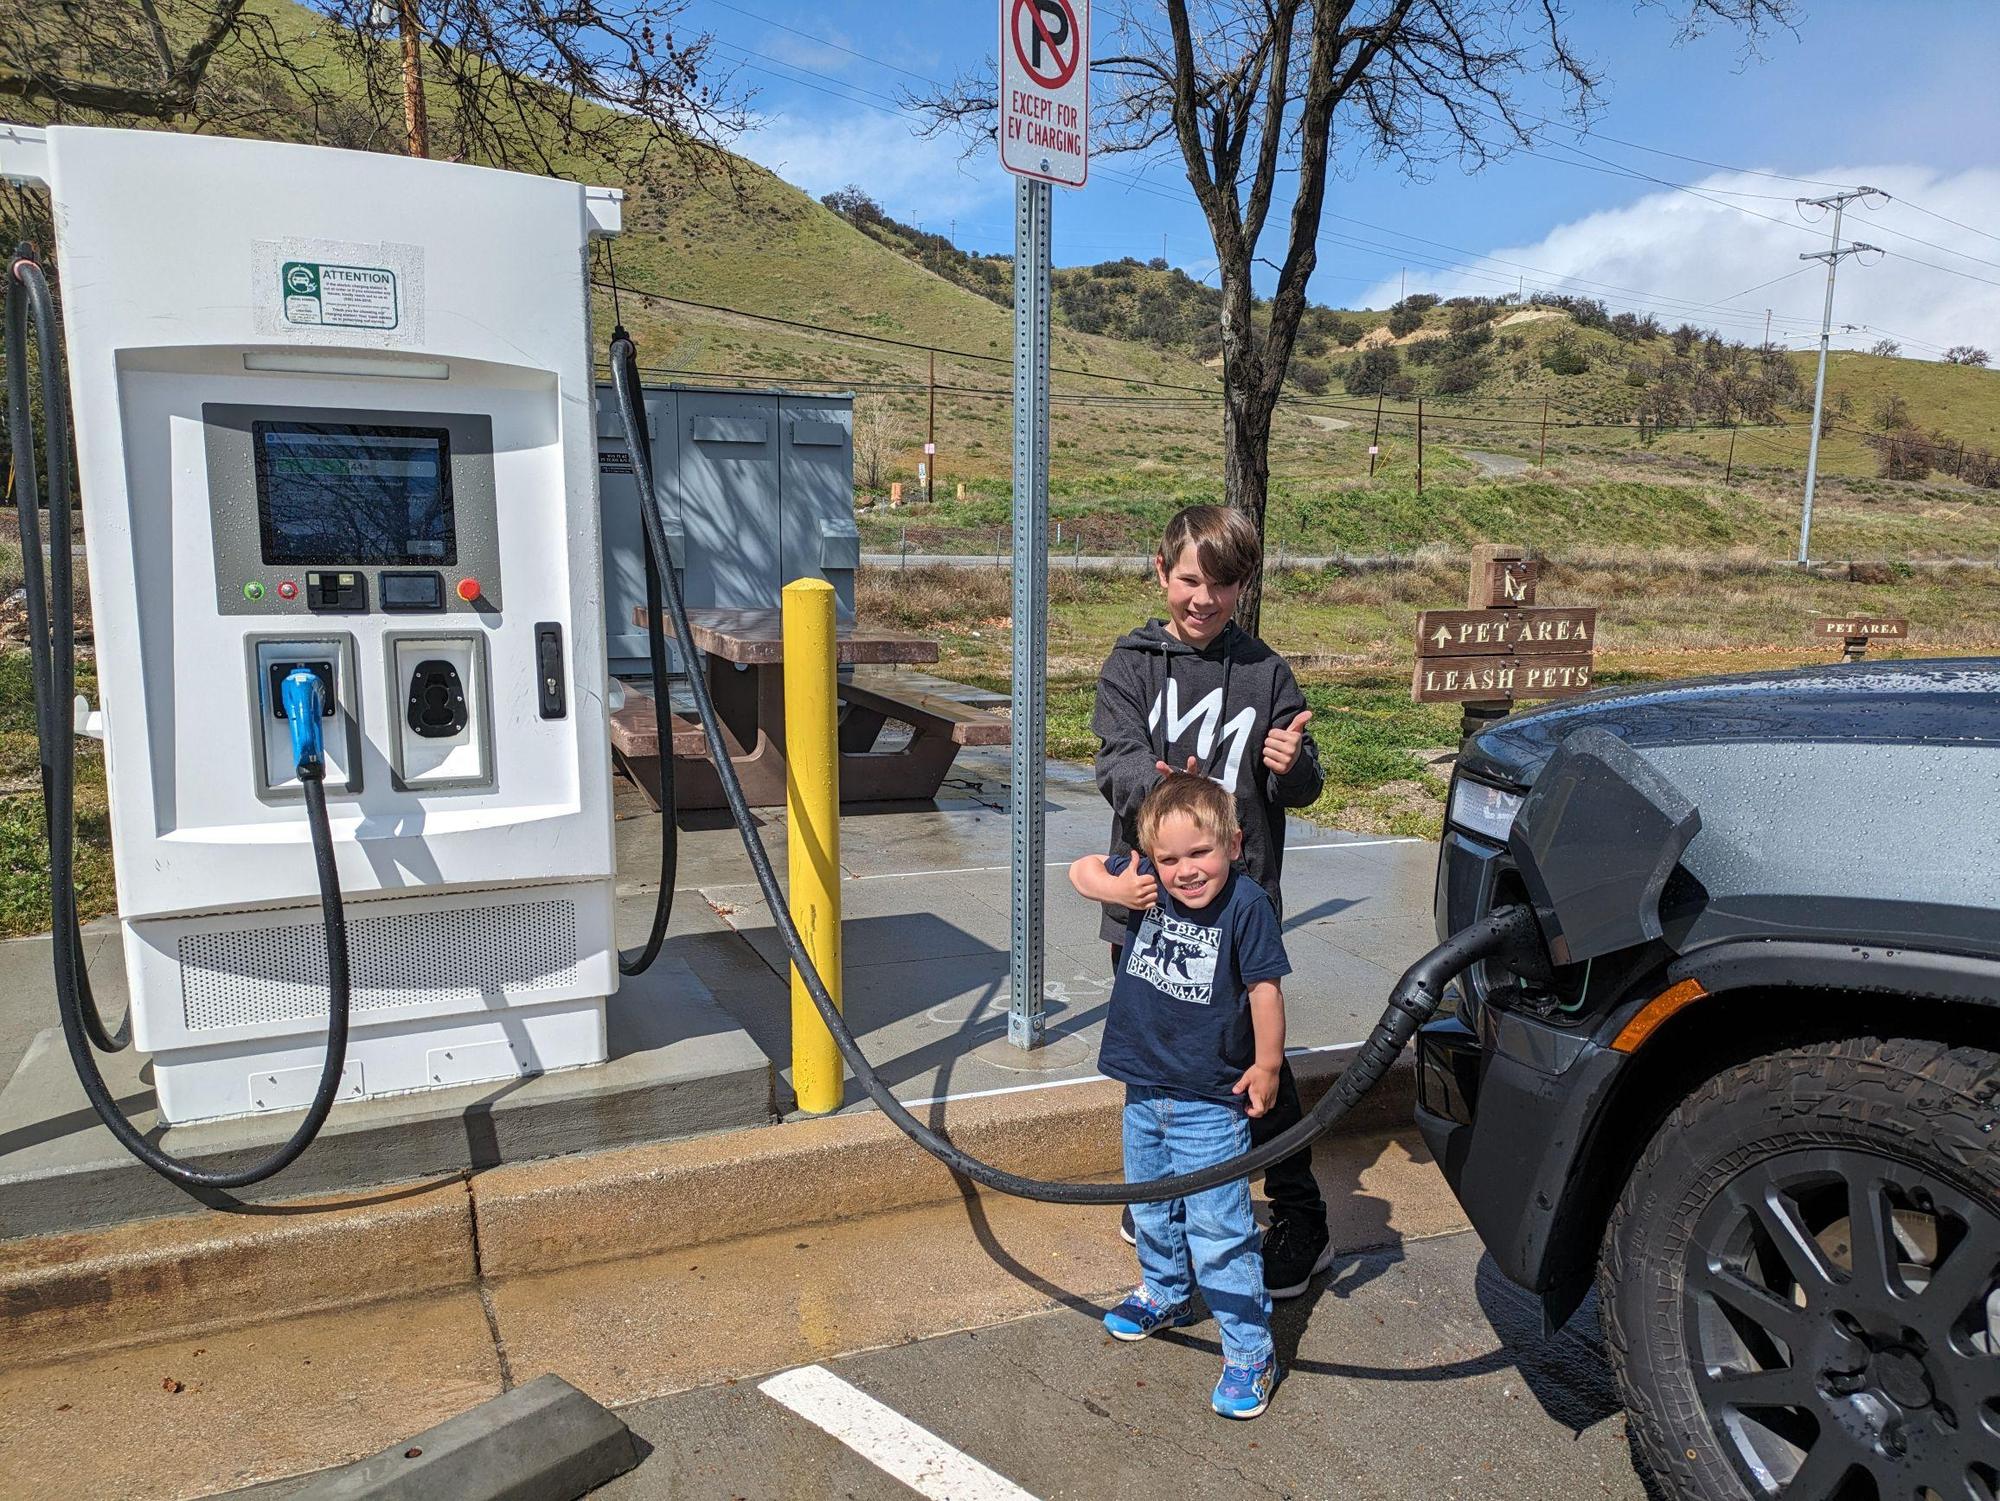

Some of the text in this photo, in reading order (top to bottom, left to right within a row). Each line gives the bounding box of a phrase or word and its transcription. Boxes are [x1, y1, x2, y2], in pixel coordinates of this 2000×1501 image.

[1012, 90, 1077, 130] EXCEPT FOR
[1008, 116, 1081, 156] EV CHARGING
[322, 270, 390, 284] ATTENTION
[1458, 620, 1587, 644] PET AREA
[1826, 623, 1898, 634] PET AREA
[1424, 666, 1589, 692] LEASH PETS
[1178, 922, 1219, 947] BEAR
